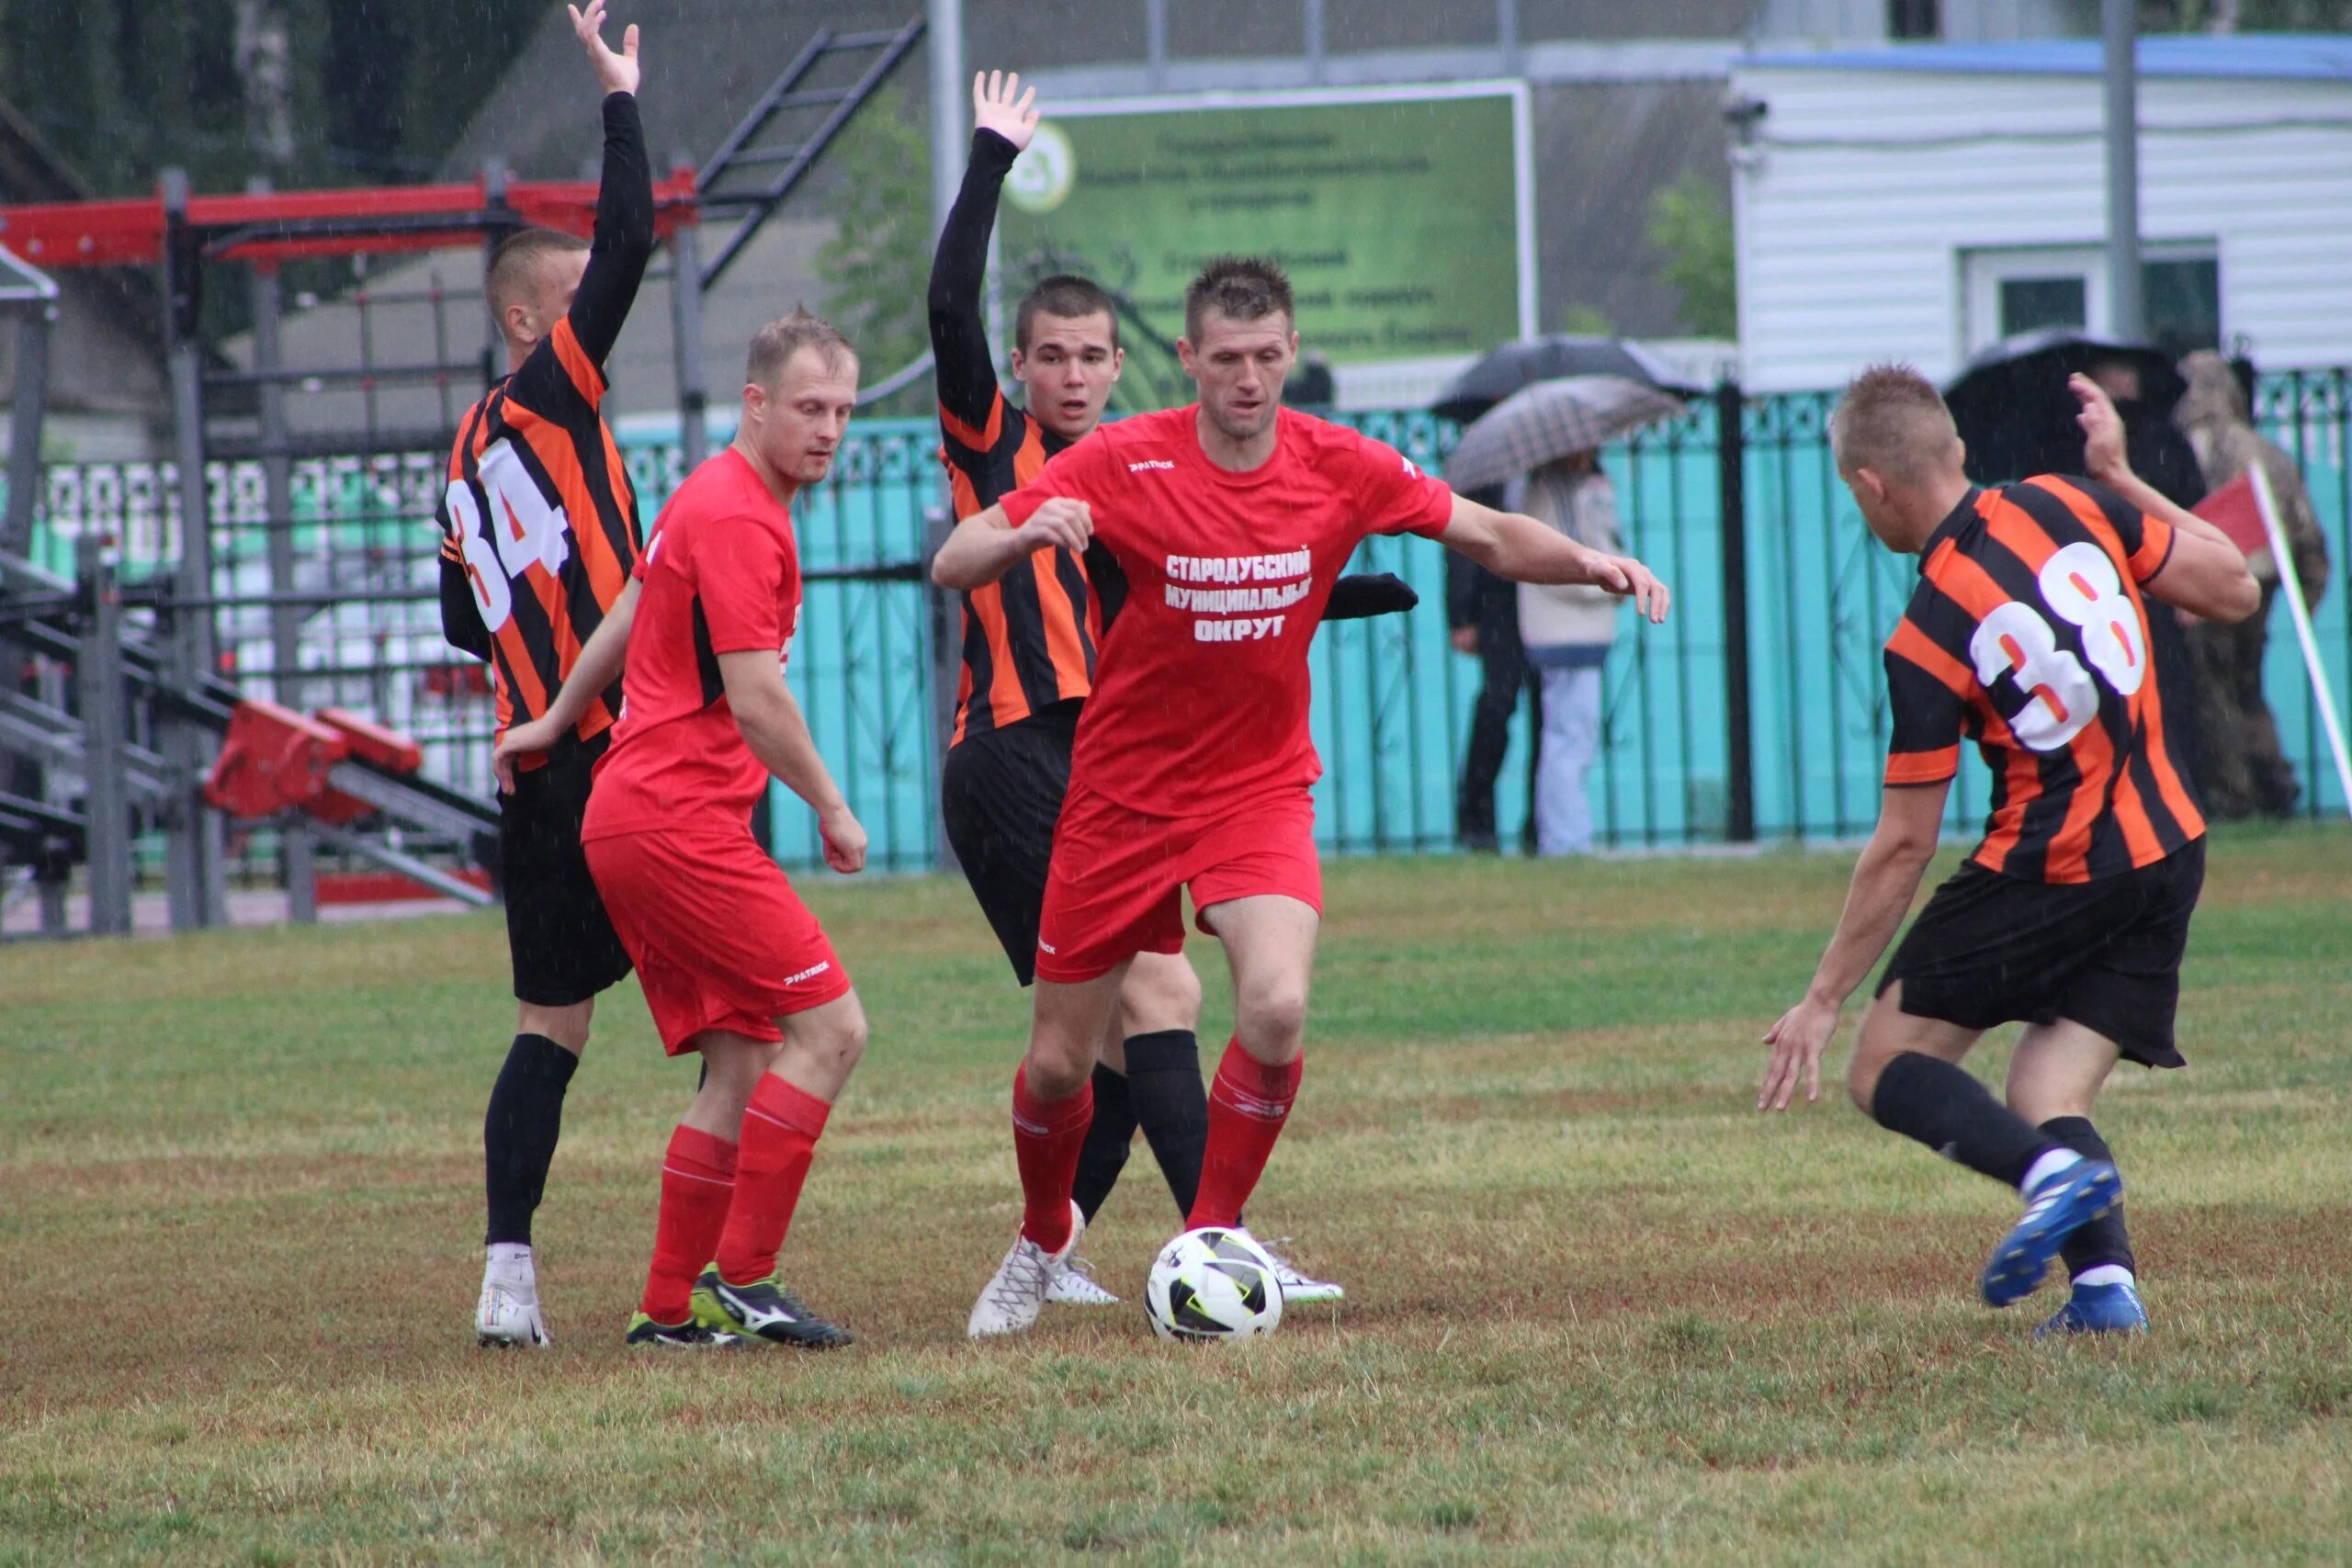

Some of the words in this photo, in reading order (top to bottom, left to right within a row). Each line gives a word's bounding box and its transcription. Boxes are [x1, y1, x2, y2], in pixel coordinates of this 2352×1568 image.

[1166, 544, 1311, 584] СТАРОДУБСКИЙ
[1194, 615, 1285, 641] ОКРУГ
[1970, 541, 2145, 750] 38
[793, 960, 830, 983] PATRICK
